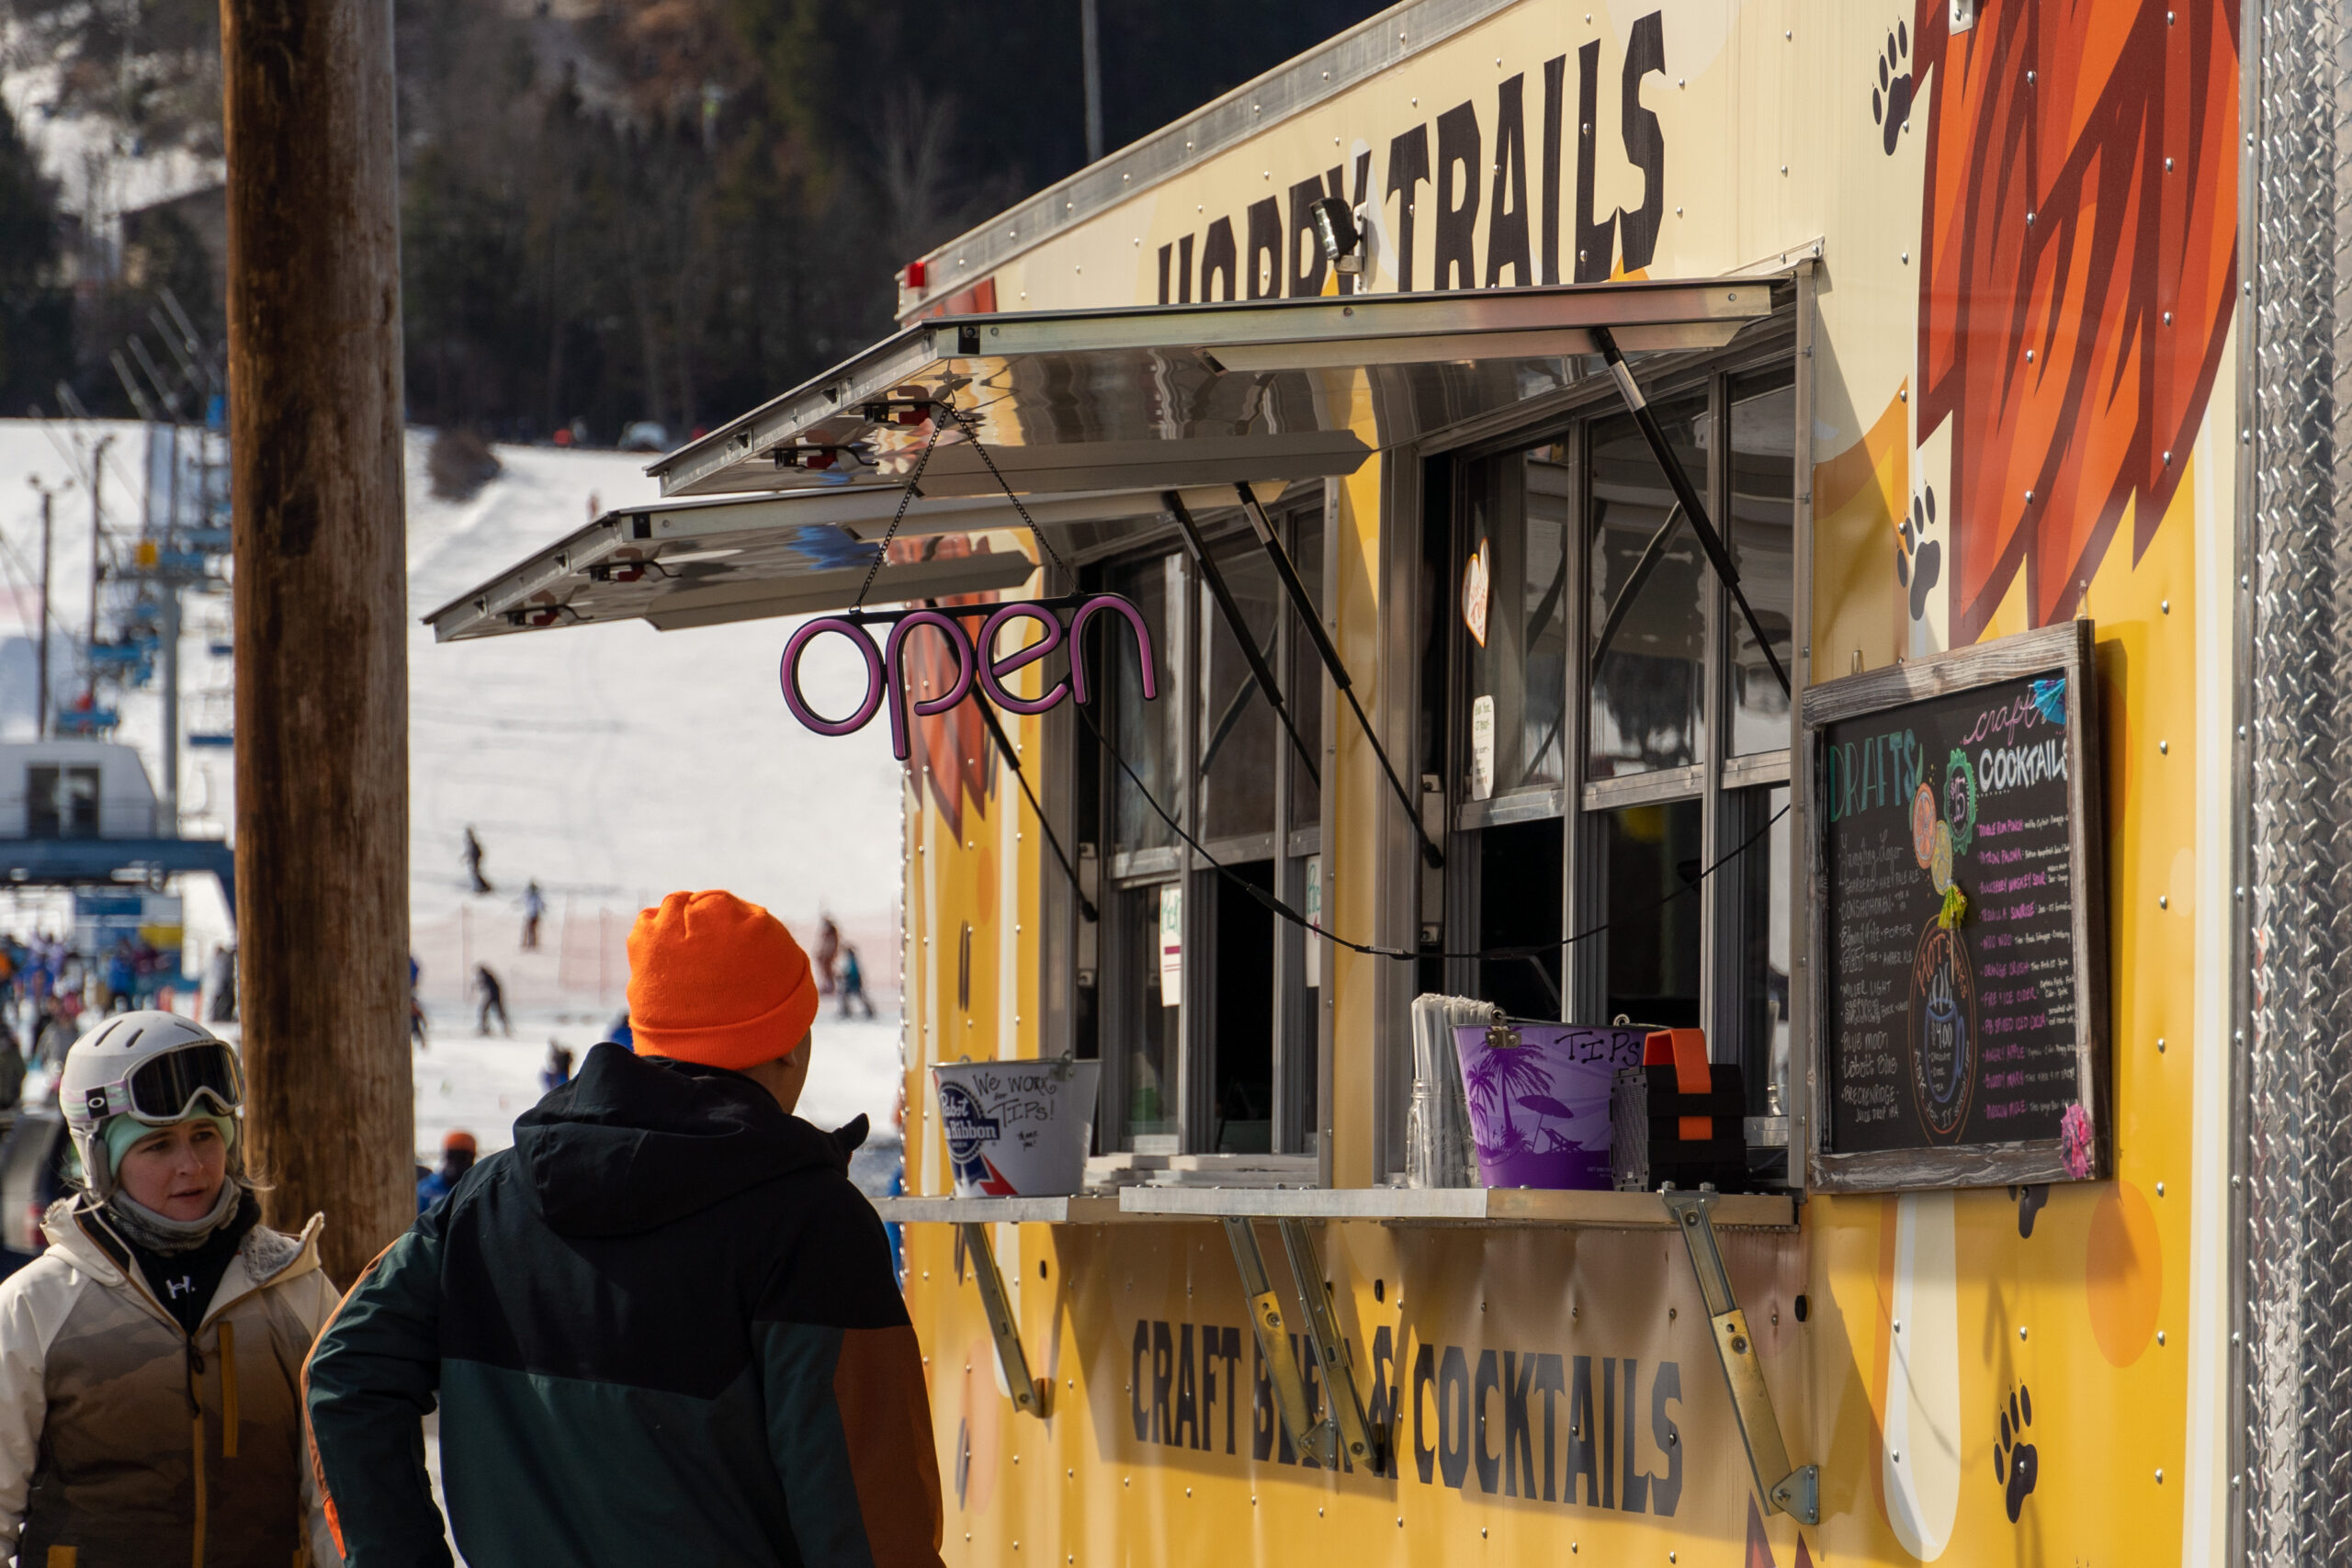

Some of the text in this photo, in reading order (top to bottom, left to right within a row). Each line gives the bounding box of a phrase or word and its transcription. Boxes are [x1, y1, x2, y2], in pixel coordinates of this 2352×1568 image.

[1385, 9, 1667, 293] TRAILS
[780, 593, 1157, 761] open
[1829, 728, 1917, 823] DRAFTS
[1883, 923, 1915, 940] PORTER
[1554, 1030, 1641, 1067] TIPS
[972, 1072, 1001, 1097] We
[939, 1092, 970, 1118] Pabst
[988, 1098, 1055, 1129] TIPS!
[1132, 1319, 1243, 1456] CRAFT
[1413, 1343, 1683, 1517] COCKTAILS
